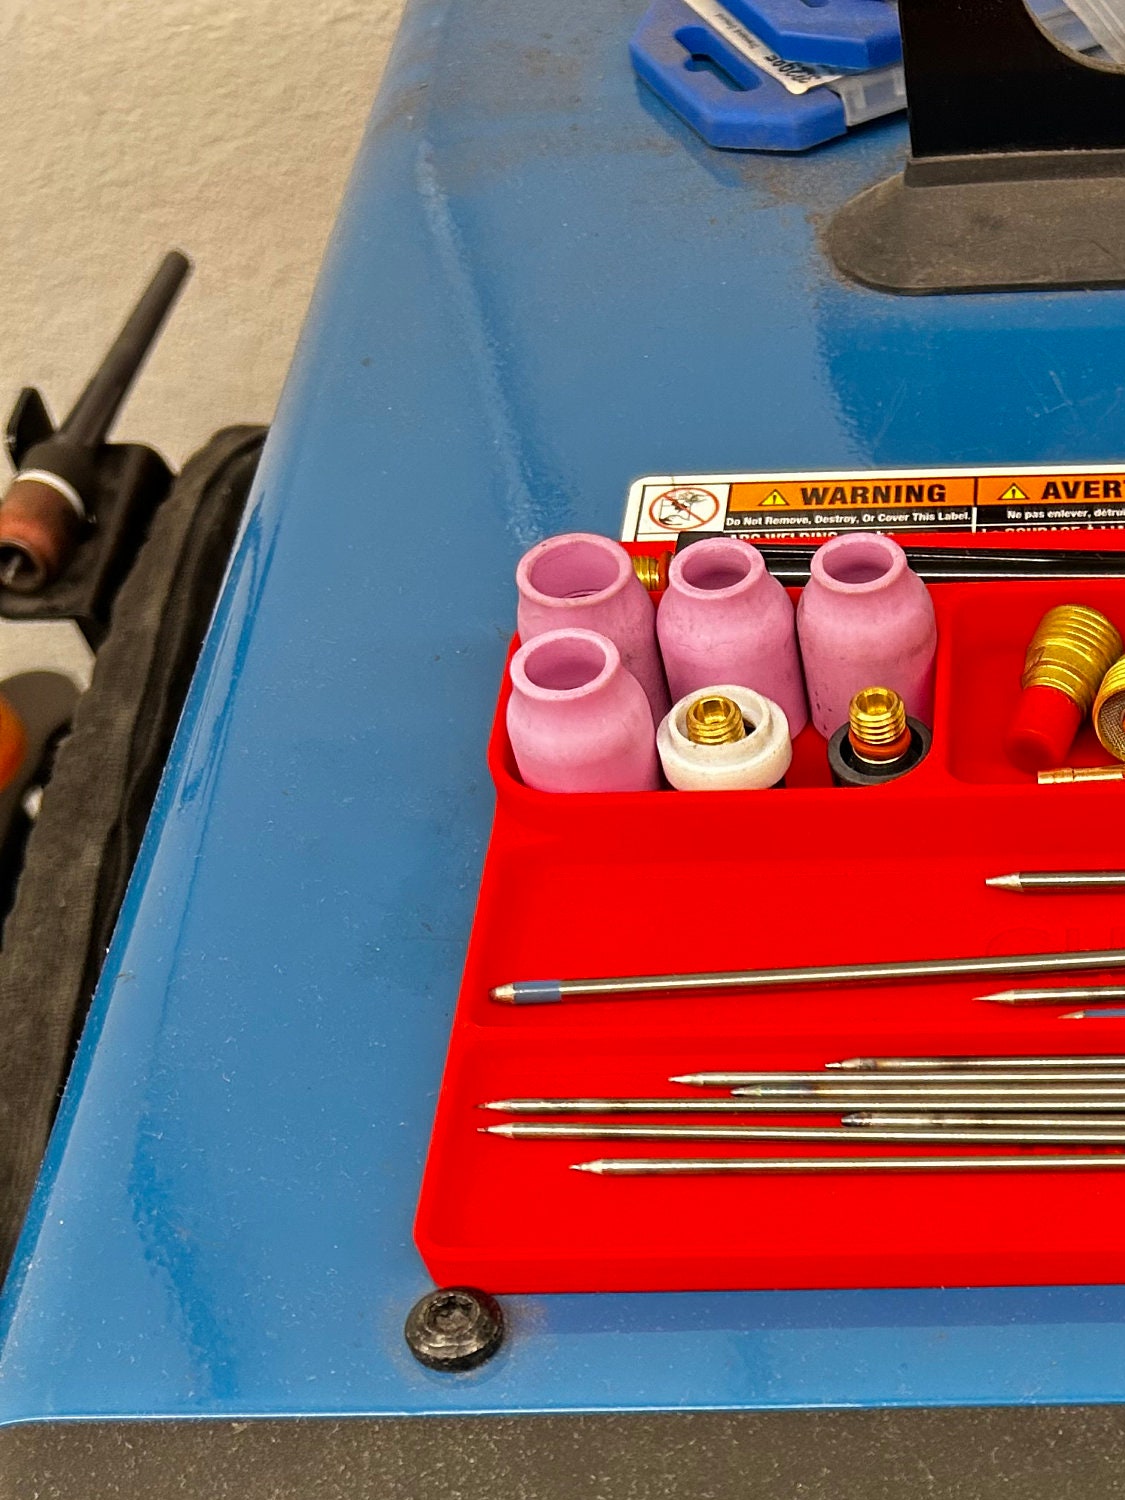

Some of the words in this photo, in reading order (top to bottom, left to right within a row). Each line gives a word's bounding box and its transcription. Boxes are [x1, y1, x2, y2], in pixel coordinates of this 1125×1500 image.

[800, 484, 946, 505] WARNING
[726, 517, 740, 526] Do
[743, 516, 762, 526] Not
[765, 516, 812, 526] Remove,
[814, 514, 860, 526] Destroy,
[862, 513, 876, 523] Or
[877, 512, 910, 523] Cover
[912, 512, 936, 522] This
[938, 511, 971, 521] Label.
[1007, 510, 1021, 520] Ne
[1024, 510, 1045, 521] pas
[1047, 508, 1092, 519] enlever,
